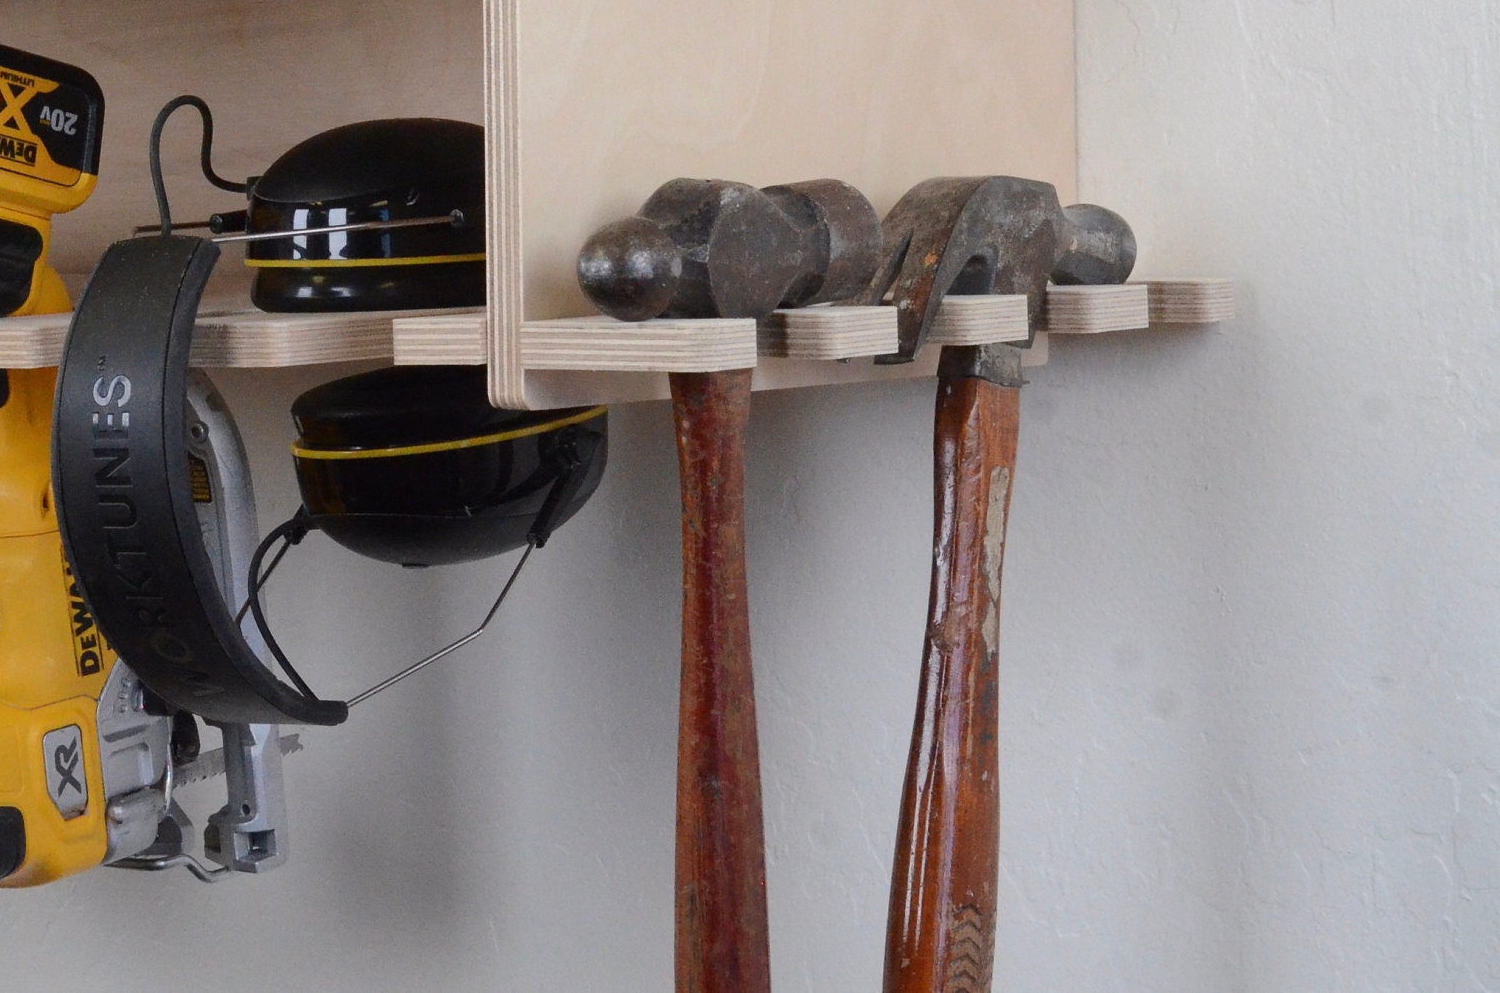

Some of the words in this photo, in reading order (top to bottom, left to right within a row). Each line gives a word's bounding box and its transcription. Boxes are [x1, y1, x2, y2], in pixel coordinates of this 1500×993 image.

[0, 69, 35, 87] LITHIUM
[67, 566, 100, 677] DEWA
[54, 736, 82, 799] XR
